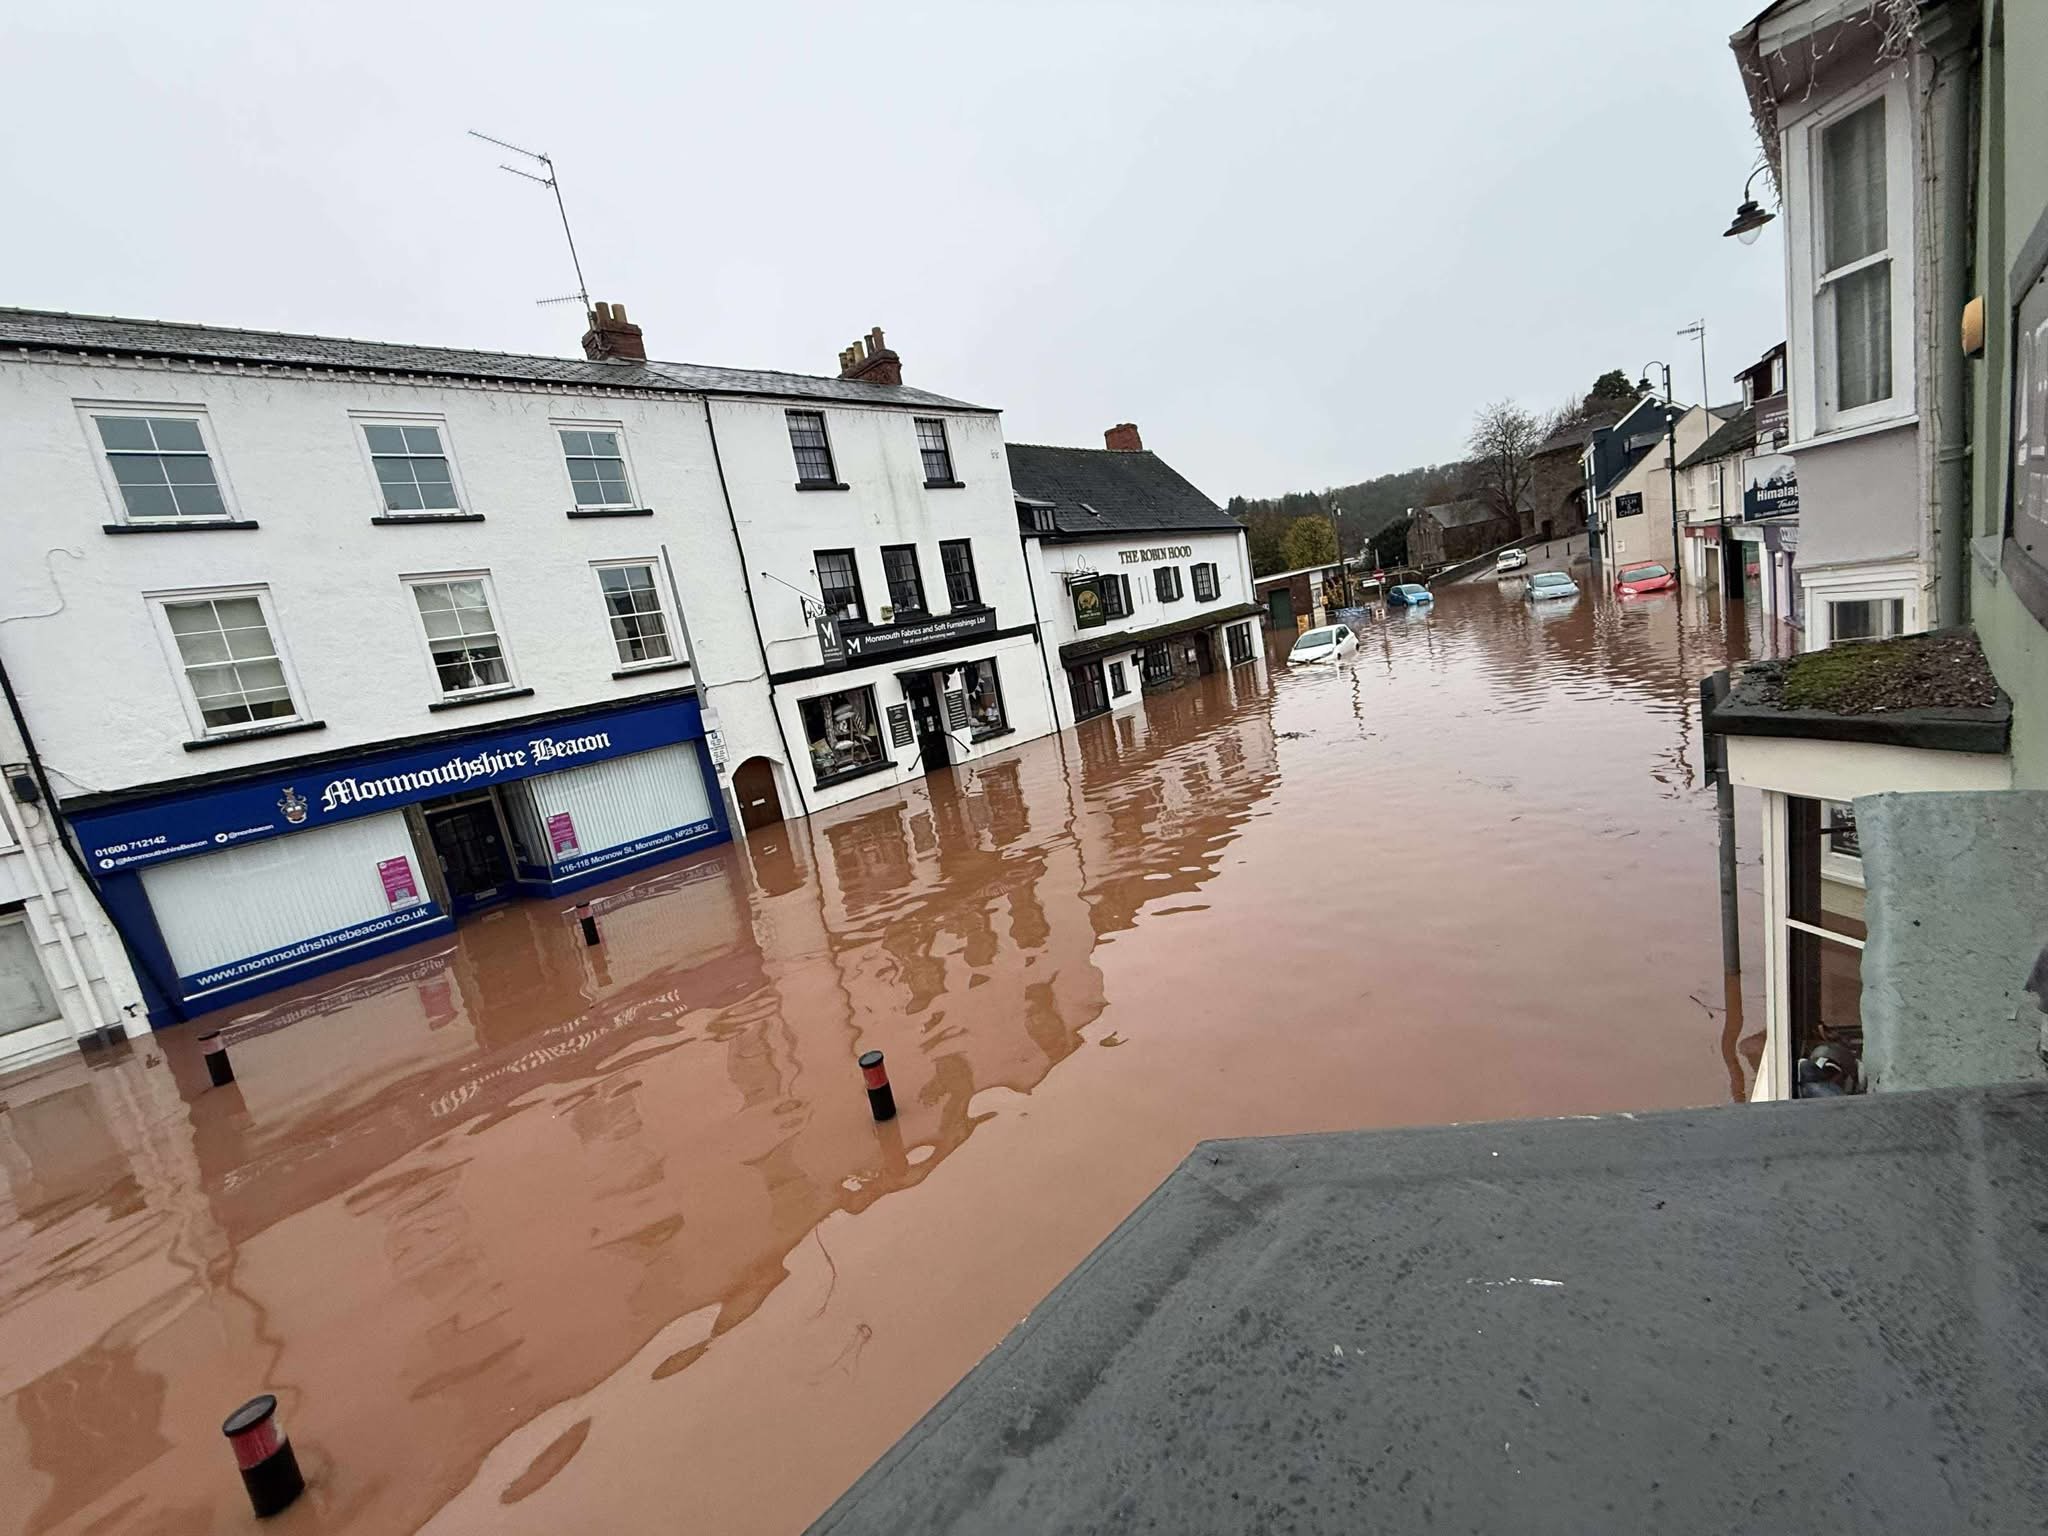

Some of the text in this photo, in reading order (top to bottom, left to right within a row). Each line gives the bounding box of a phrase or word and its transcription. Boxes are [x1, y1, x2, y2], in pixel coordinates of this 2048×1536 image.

[1118, 545, 1192, 564] THE ROBIN HOOD
[865, 616, 986, 645] Monmouth Fabrics and Soft Furnishings Ltd
[321, 732, 611, 812] Monmouthshire Beacon
[228, 823, 275, 840] @monbeacon
[95, 835, 168, 858] 01600 712142
[115, 839, 209, 866] @MonmouthshireBeacon
[560, 858, 590, 874] 116-118
[591, 850, 623, 865] Monnow
[635, 835, 675, 852] Monmouth,
[675, 828, 694, 839] NP25
[694, 822, 709, 833] 3EQ
[196, 906, 429, 987] www.monmouthshirebeacon.co.uk
